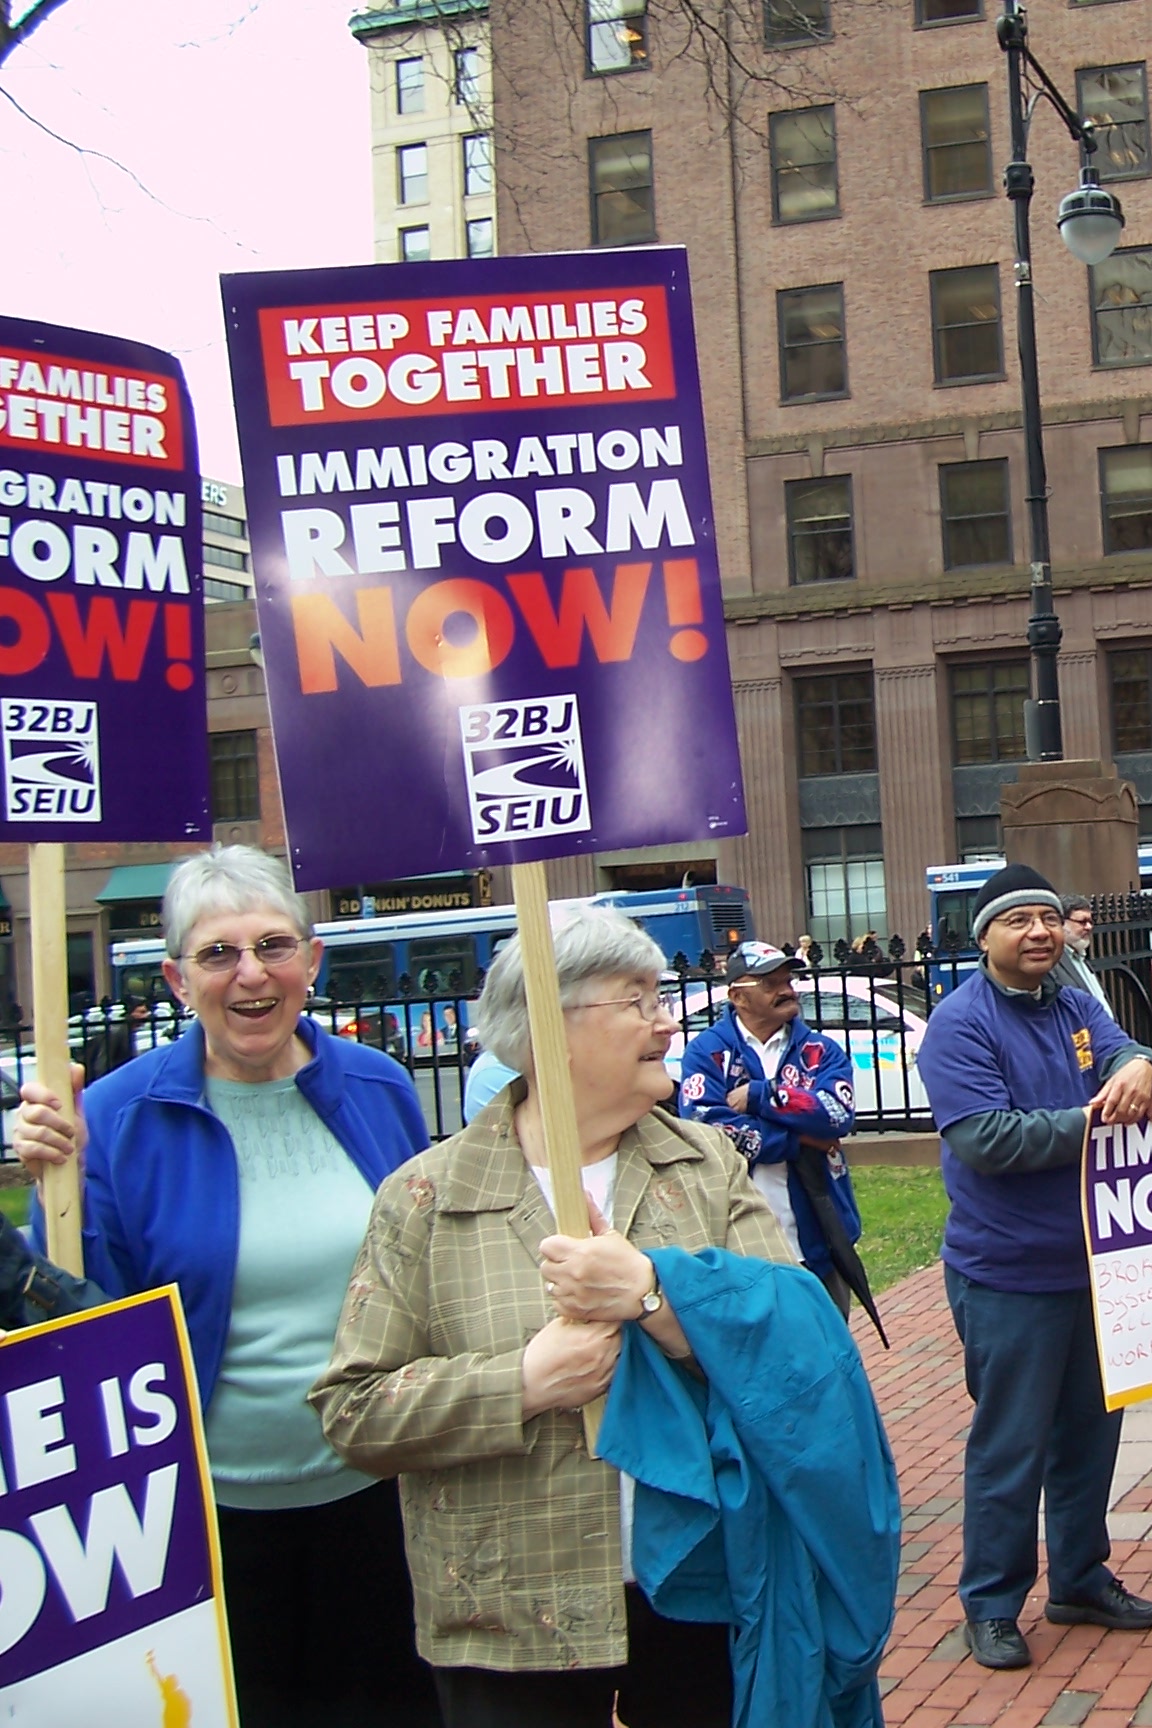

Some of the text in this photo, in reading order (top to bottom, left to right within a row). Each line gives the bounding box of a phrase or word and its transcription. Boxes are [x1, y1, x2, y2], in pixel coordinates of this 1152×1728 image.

[283, 299, 648, 356] KEEP FAMILIES
[0, 357, 168, 413] FAMILIES
[290, 341, 652, 412] TOGETHER
[0, 394, 168, 458] ETHER
[277, 425, 684, 497] IMMIGRATION
[0, 516, 190, 594] ORM
[280, 478, 695, 581] REFORM
[291, 558, 709, 695] NOW!
[5, 705, 94, 733] 32BJ
[465, 701, 575, 743] 32BJ
[11, 788, 96, 814] SEIU
[477, 794, 583, 836] SEIU
[412, 893, 471, 909] DONUTS
[101, 1362, 178, 1458] IS
